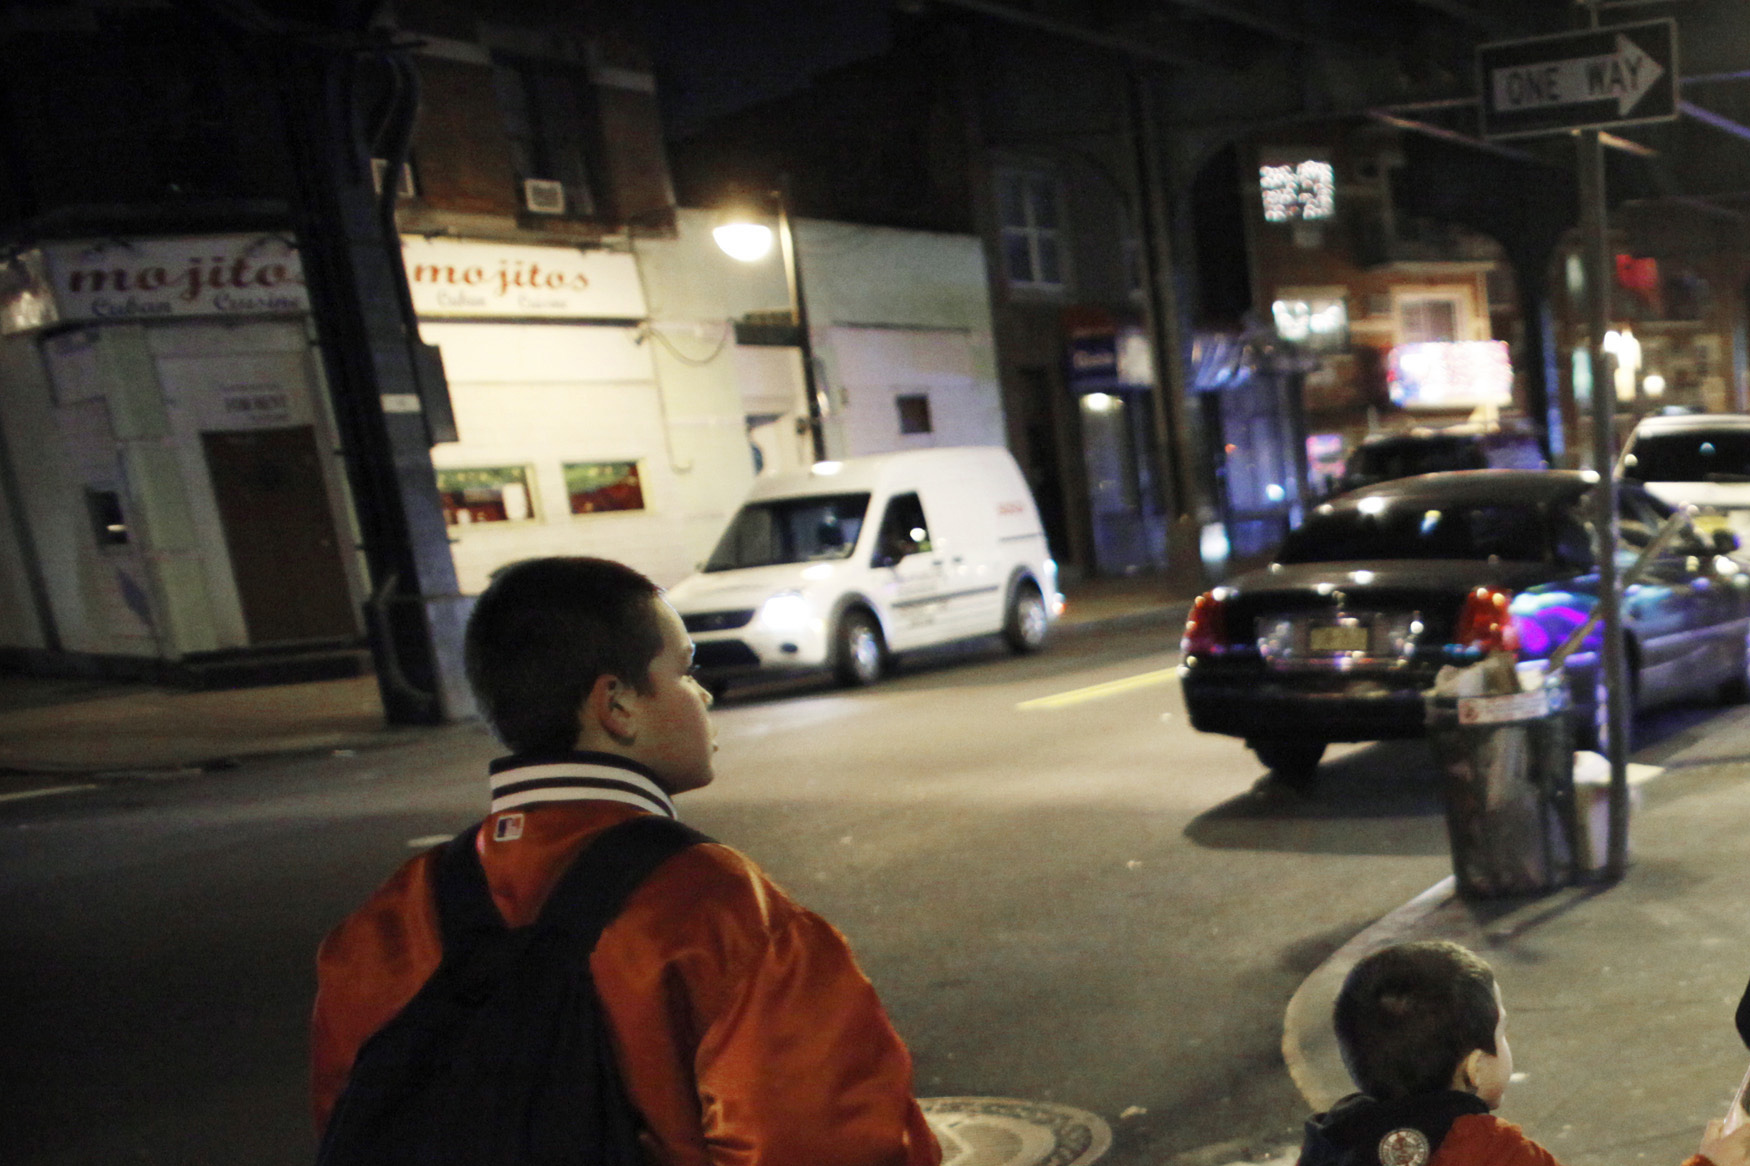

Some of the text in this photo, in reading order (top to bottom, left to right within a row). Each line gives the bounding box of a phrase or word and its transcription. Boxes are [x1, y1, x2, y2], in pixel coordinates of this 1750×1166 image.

[1506, 55, 1644, 105] ONE WAY
[68, 256, 306, 303] mojito
[414, 259, 590, 297] mojitos
